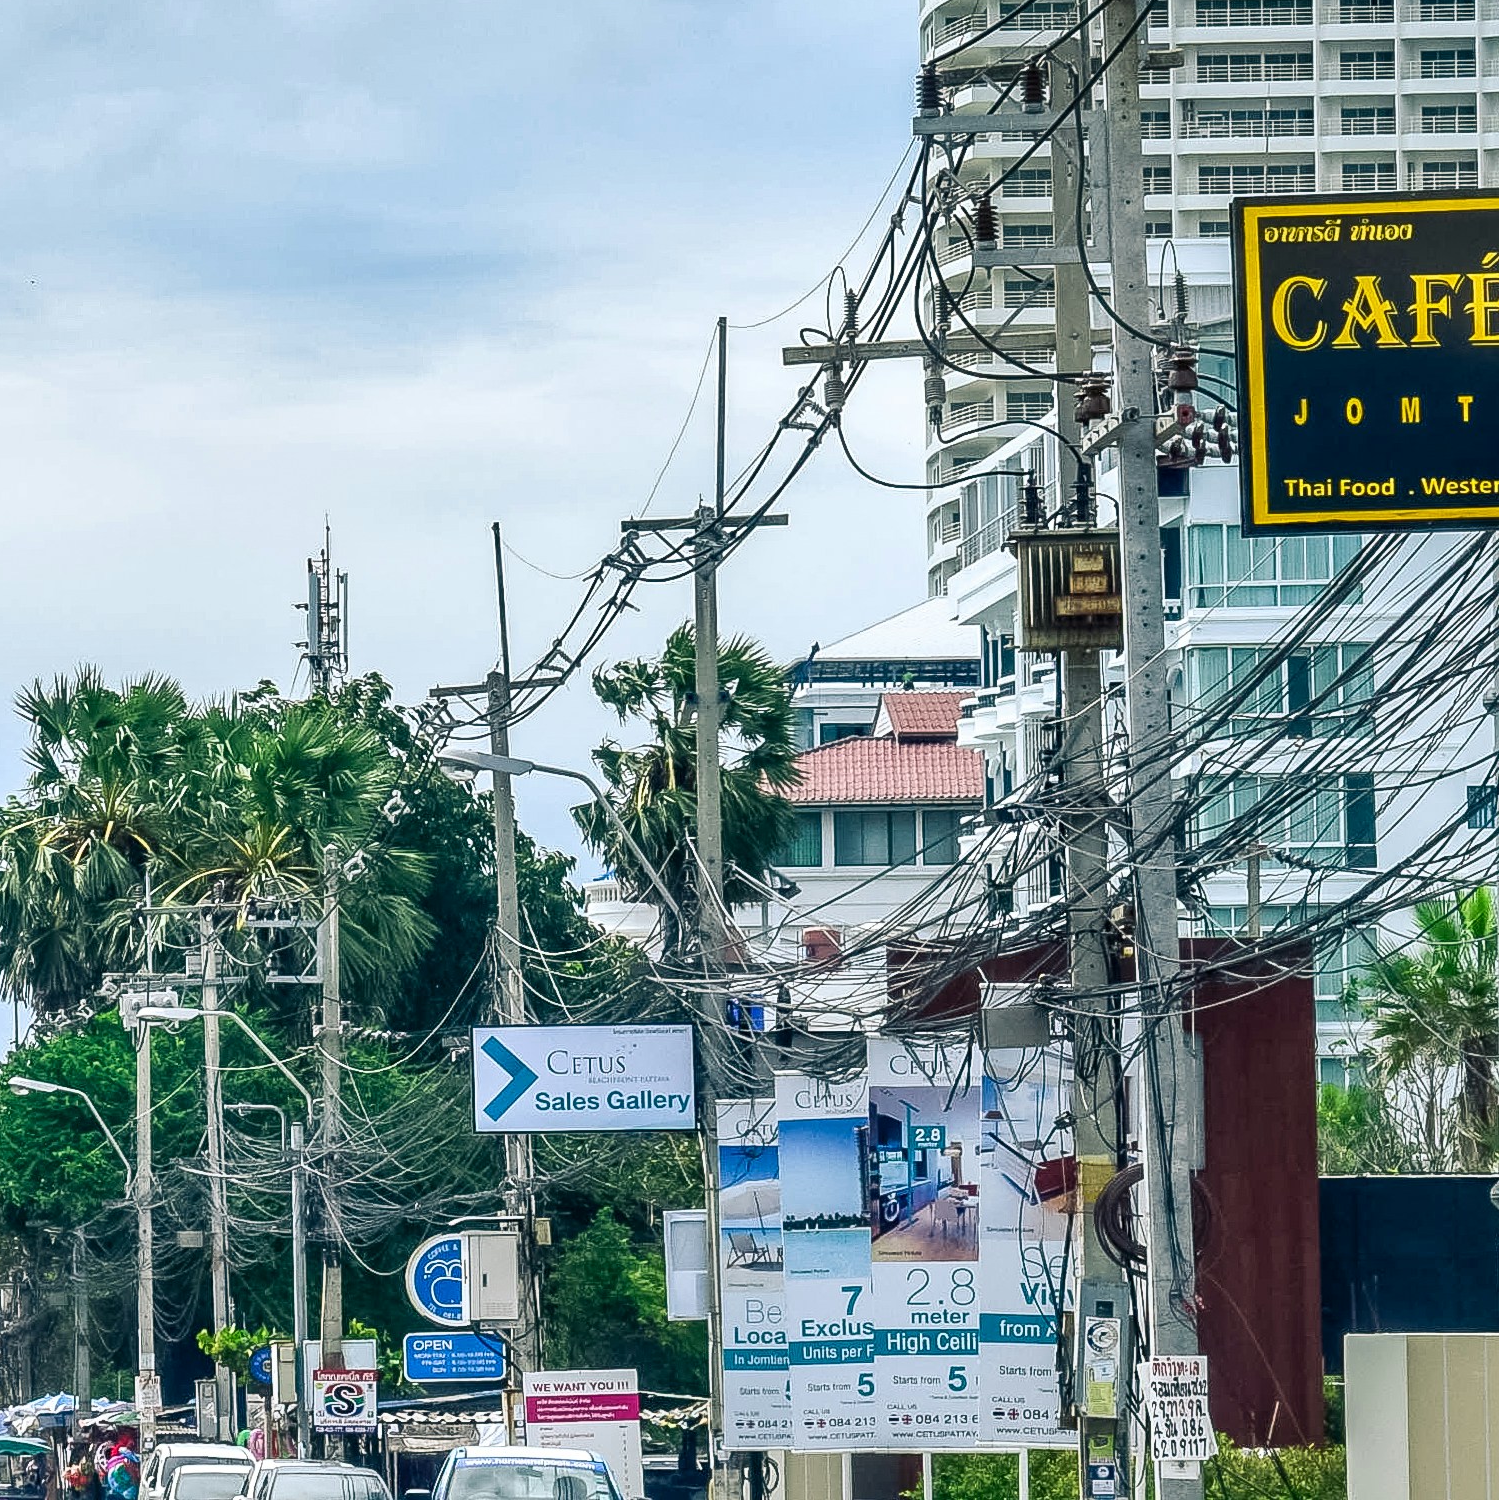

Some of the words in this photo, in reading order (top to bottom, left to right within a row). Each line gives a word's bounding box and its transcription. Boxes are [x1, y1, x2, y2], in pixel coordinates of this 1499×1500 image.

[1284, 478, 1332, 497] Thai
[1340, 478, 1395, 496] Food
[535, 1092, 600, 1111] Sales
[606, 1090, 691, 1113] Gallery
[914, 1128, 941, 1142] 2.8
[907, 1268, 975, 1306] 2.8
[841, 1286, 863, 1316] 7
[746, 1299, 782, 1324] Be
[911, 1309, 970, 1324] meter
[734, 1327, 787, 1344] Loca
[801, 1319, 874, 1337] Exclus
[1000, 1320, 1040, 1337] from
[413, 1340, 453, 1351] OPEN
[887, 1333, 930, 1354] High
[937, 1332, 977, 1351] Ceili
[734, 1354, 744, 1365] In
[803, 1346, 837, 1360] Units
[842, 1347, 862, 1360] per
[893, 1376, 918, 1385] Starts
[921, 1376, 941, 1385] from
[948, 1366, 967, 1392] 5
[999, 1365, 1026, 1376] Starts
[1029, 1366, 1052, 1376] from
[533, 1383, 551, 1392] WE
[553, 1382, 586, 1392] WANT
[589, 1382, 614, 1391] YOU
[807, 1383, 830, 1392] Starts
[832, 1383, 851, 1391] from
[857, 1373, 875, 1397] 5
[331, 1385, 358, 1417] S
[829, 1417, 851, 1427] 084
[855, 1416, 876, 1426] 213
[916, 1415, 940, 1424] 084
[945, 1414, 968, 1424] 213
[1023, 1409, 1048, 1420] 084
[808, 1432, 876, 1440] www.CETUSPATT
